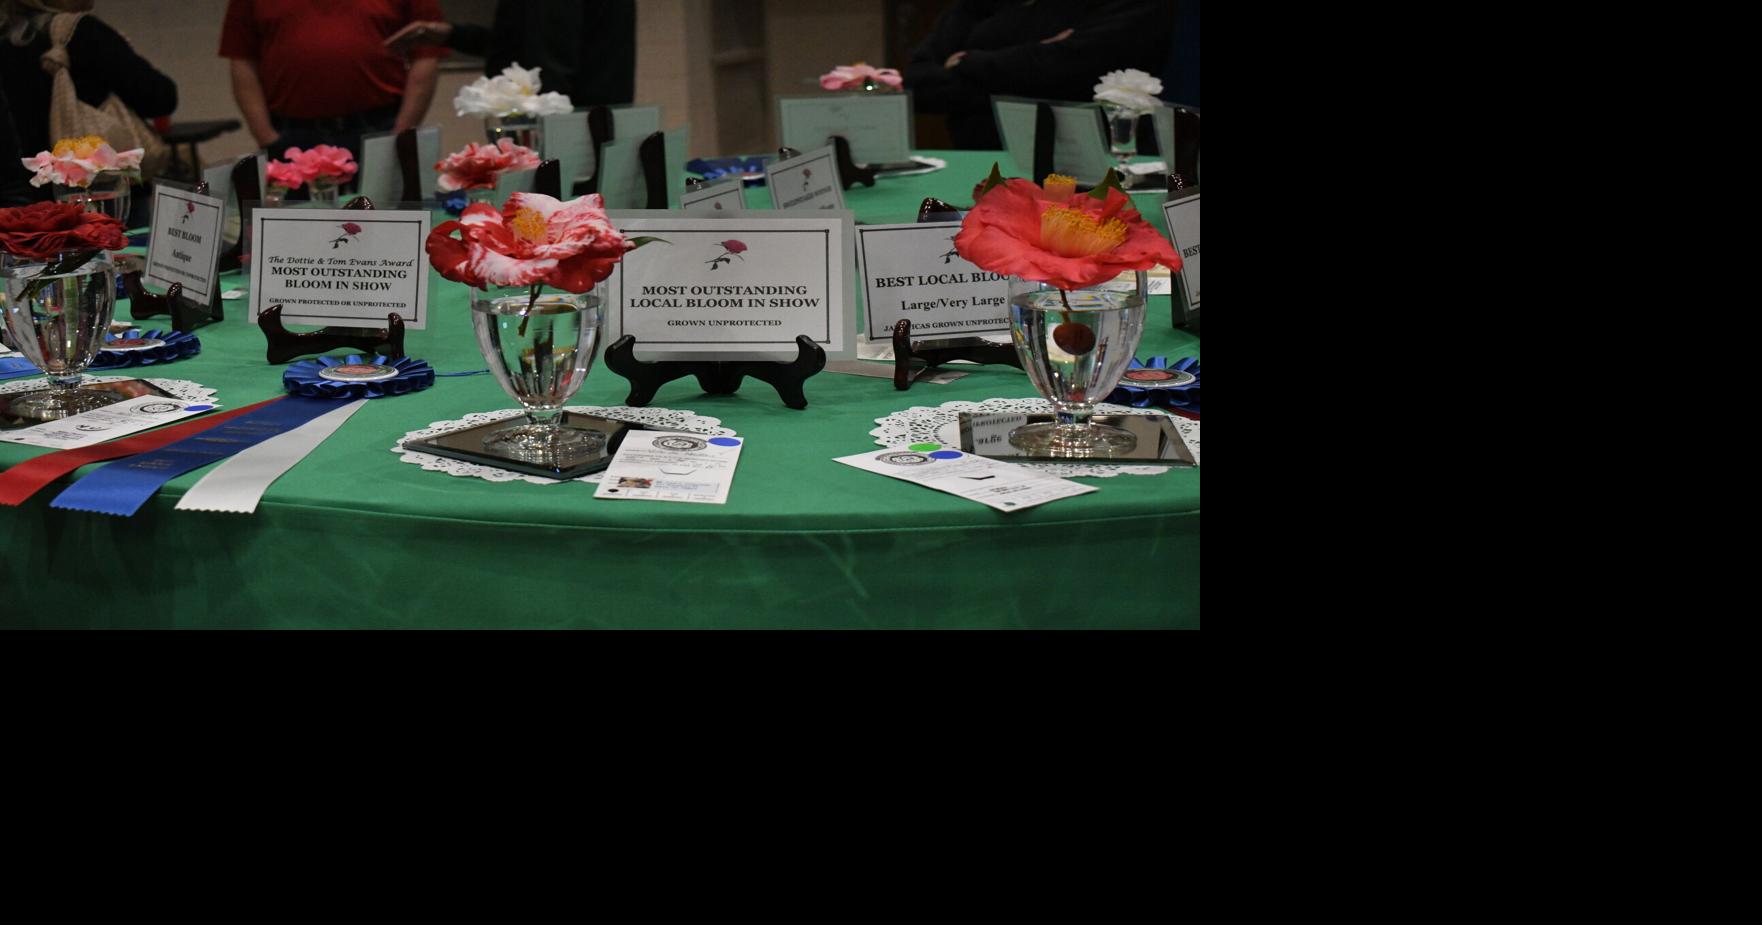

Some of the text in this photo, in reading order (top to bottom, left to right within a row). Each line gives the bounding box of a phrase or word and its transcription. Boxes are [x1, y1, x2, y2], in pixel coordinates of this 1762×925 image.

[168, 227, 202, 245] BEST BLOOM
[172, 249, 193, 263] Antique
[268, 256, 414, 268] The Dottie & Tom Evans Award
[271, 266, 407, 279] MOST OUTSTANDING
[285, 279, 392, 291] BLOOM IN SHOW
[876, 271, 1010, 289] BEST LOCAL BLOO
[642, 285, 807, 296] MOST OUTSTANDING
[269, 297, 296, 305] GROWN
[298, 298, 338, 307] PROTECTED
[352, 300, 407, 309] UNPROTECTED
[630, 298, 820, 308] LOCAL BLOOM IN SHOW
[901, 296, 1006, 312] Large/Very Large
[667, 319, 782, 327] GROWN UNPROTECTED
[883, 322, 931, 333] JAICAS
[932, 320, 964, 329] GROWN
